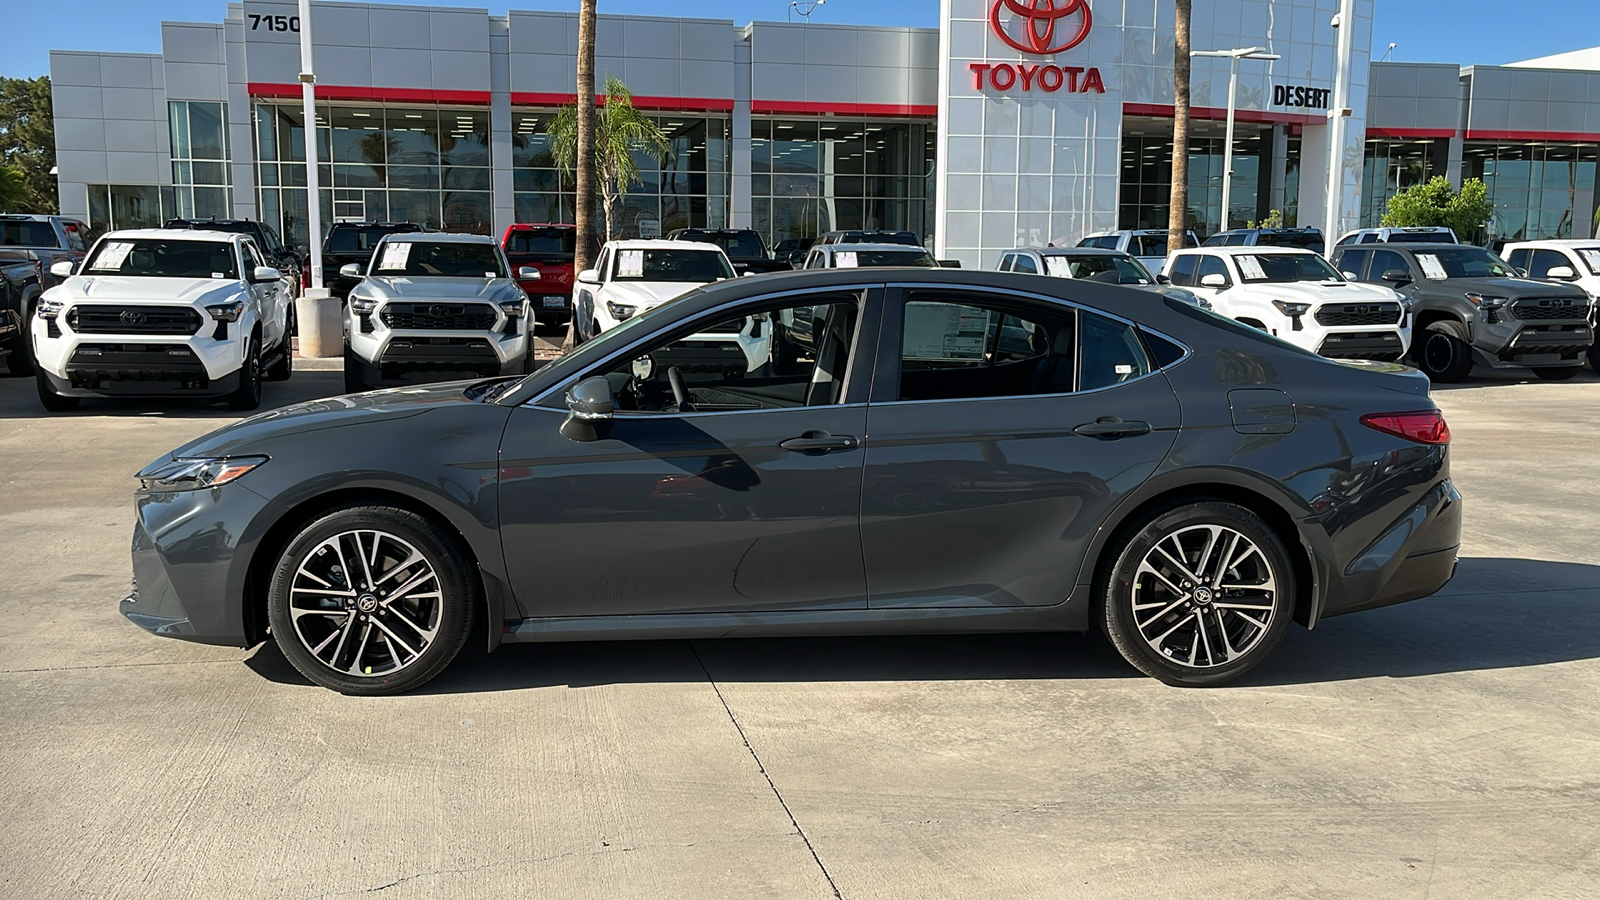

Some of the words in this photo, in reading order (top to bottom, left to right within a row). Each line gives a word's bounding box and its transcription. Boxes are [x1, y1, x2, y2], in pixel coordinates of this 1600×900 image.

[248, 14, 301, 33] 7150
[969, 62, 1106, 93] TOYOTA
[1274, 85, 1331, 109] DESERT
